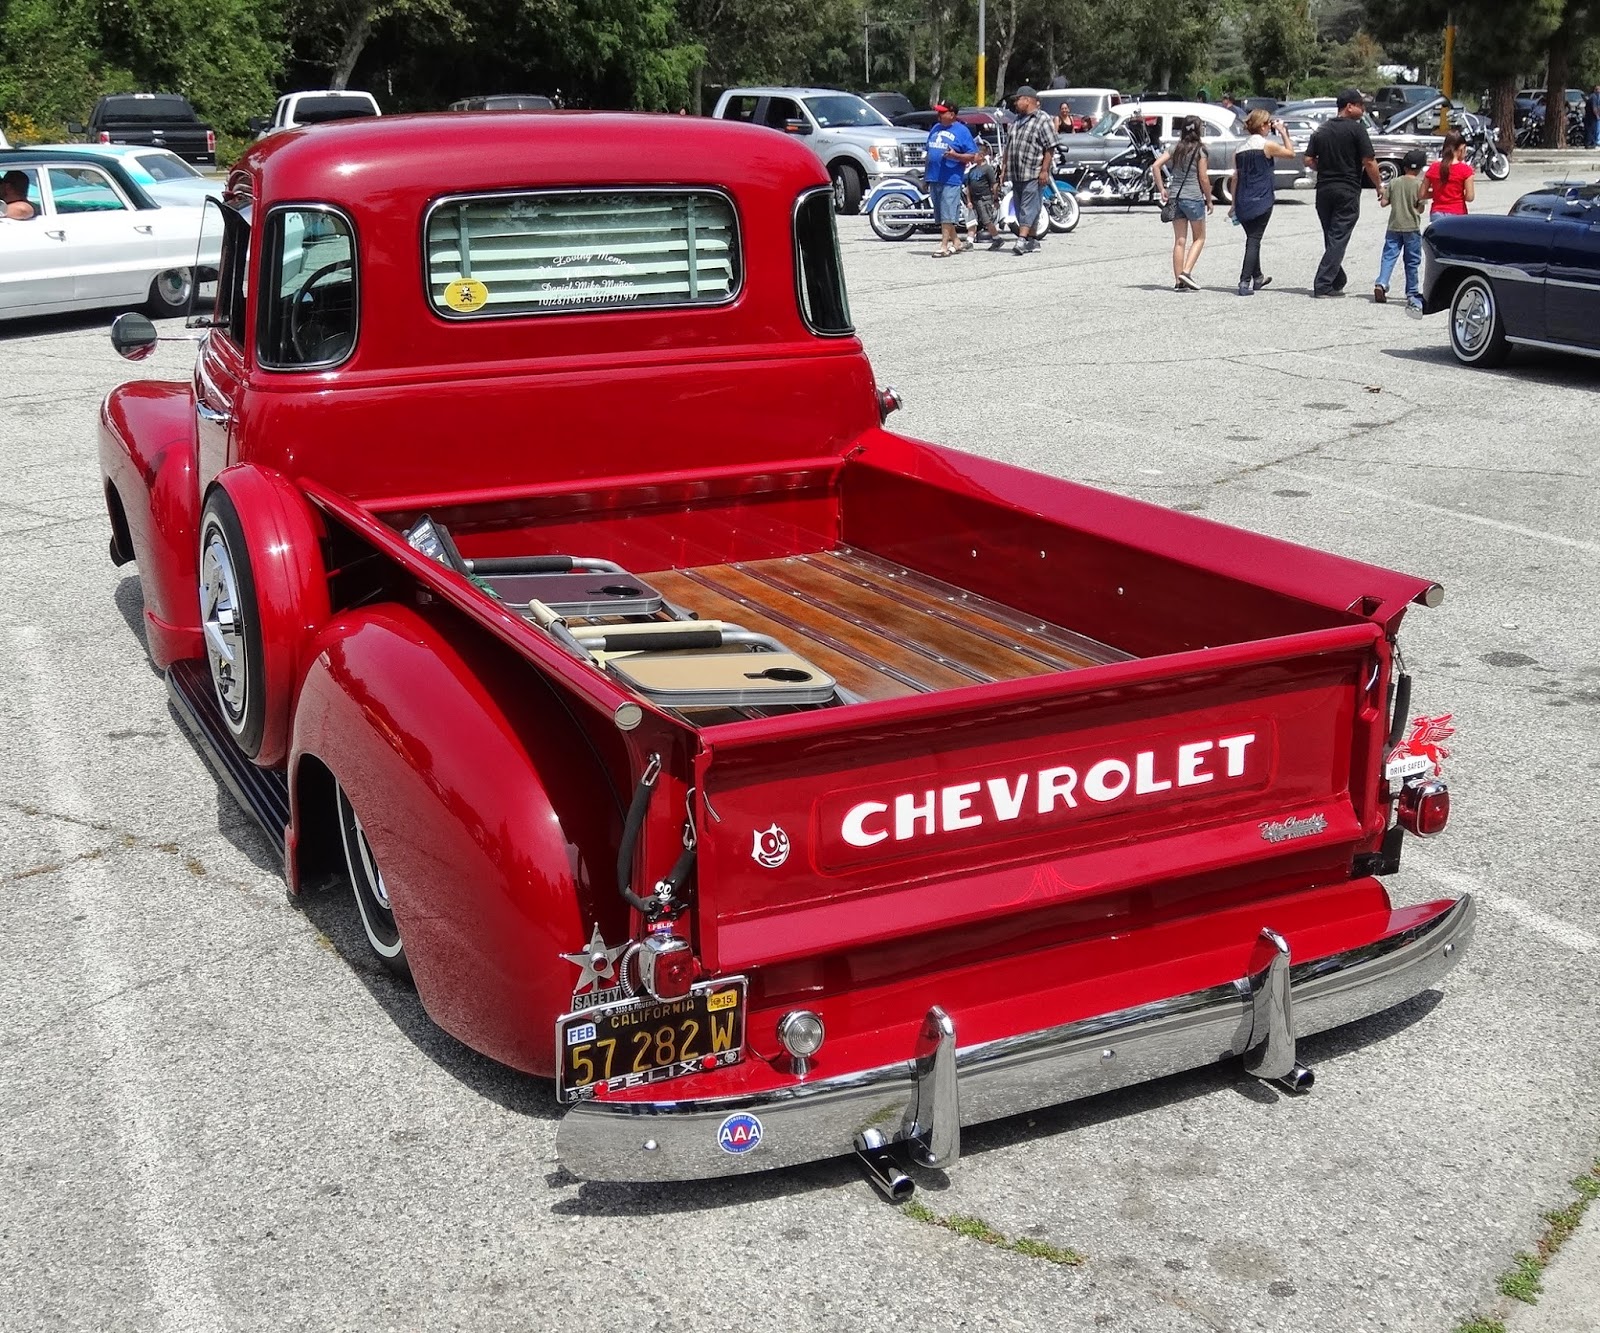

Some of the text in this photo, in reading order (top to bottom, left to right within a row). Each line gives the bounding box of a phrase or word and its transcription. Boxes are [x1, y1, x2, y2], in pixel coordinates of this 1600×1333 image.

[553, 253, 593, 267] Loving
[541, 281, 574, 292] Daniel
[575, 280, 601, 290] Mike
[1389, 760, 1427, 775] DRIVE SAFELY
[841, 733, 1256, 848] CHEVROLET
[1269, 827, 1324, 844] LOS ANGELES
[652, 921, 675, 931] FELIX
[574, 988, 620, 1011] SAFETY
[721, 994, 732, 1004] 15
[611, 1000, 695, 1029] CALIFORNIA
[569, 1025, 594, 1043] FEB
[572, 1011, 734, 1087] 57 282 W
[607, 1060, 698, 1089] FELIX
[720, 1124, 760, 1143] AAA
